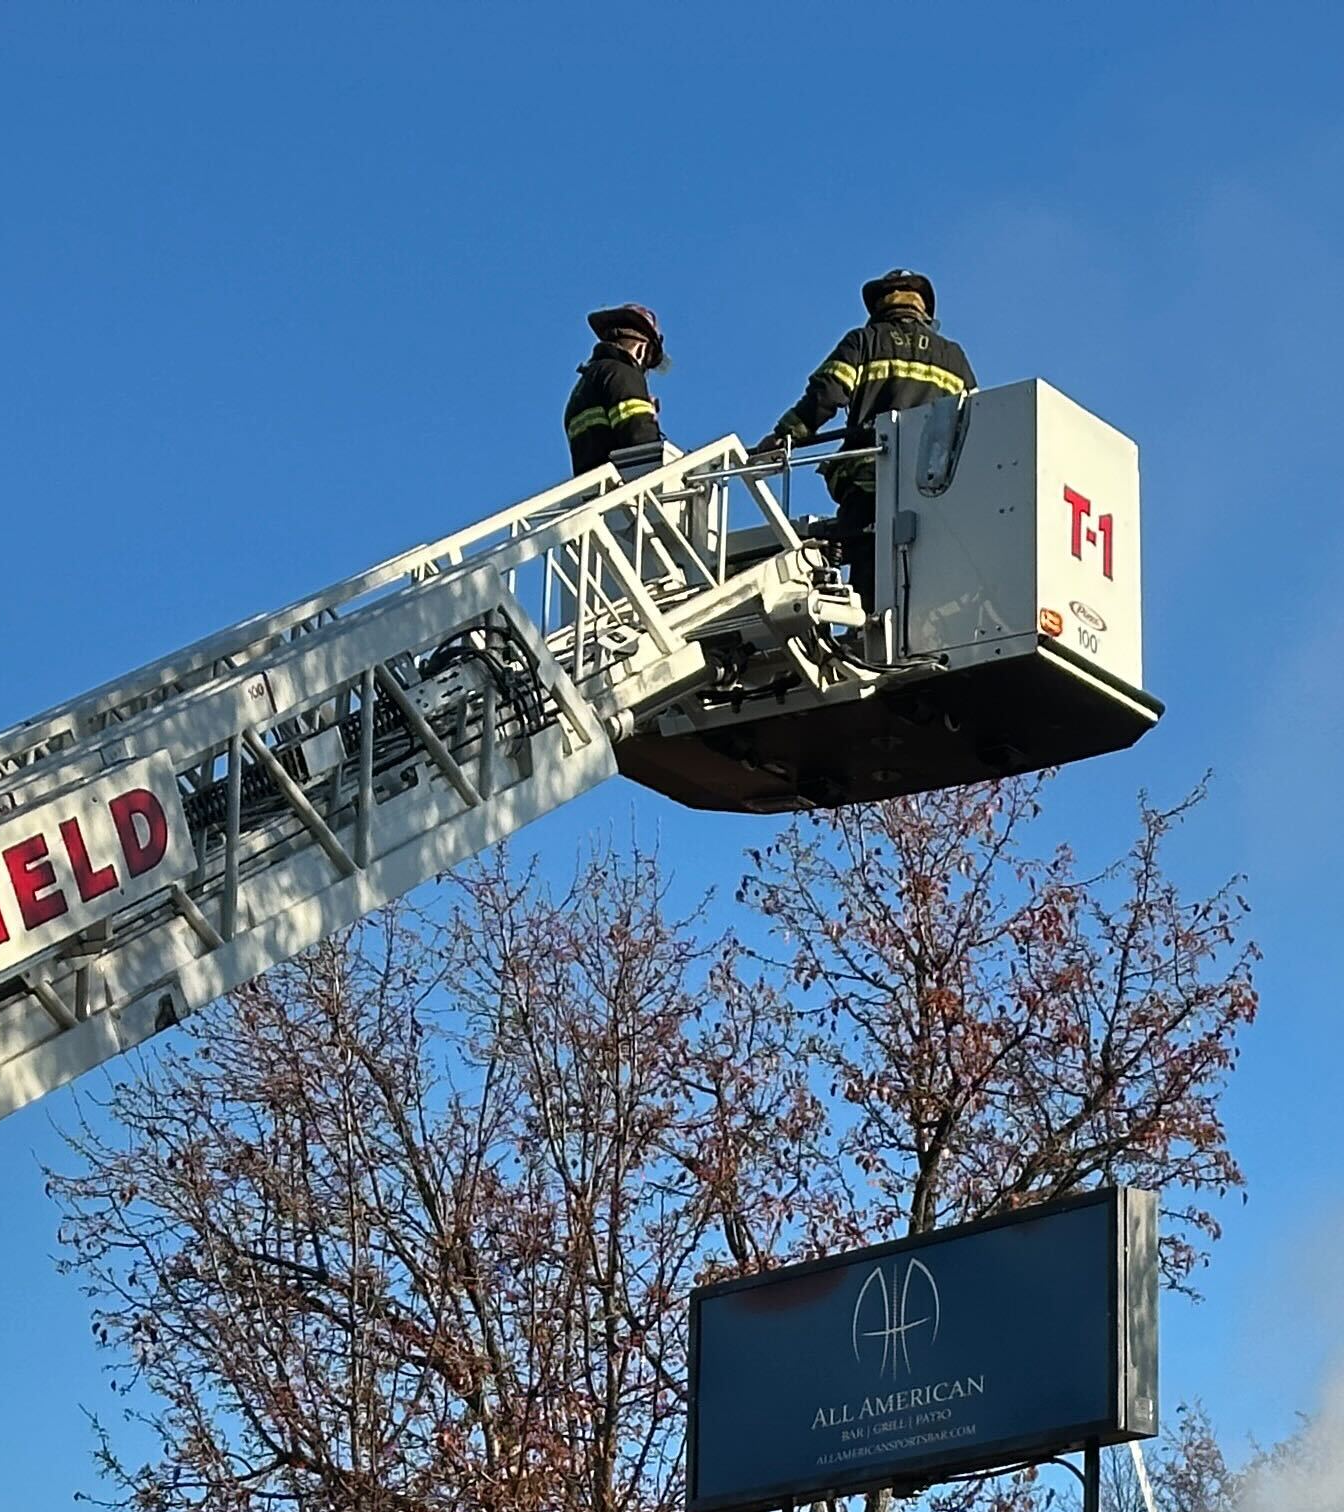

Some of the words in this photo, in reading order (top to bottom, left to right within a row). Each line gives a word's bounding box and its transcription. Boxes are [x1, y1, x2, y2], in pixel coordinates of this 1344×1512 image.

[1064, 483, 1113, 582] T-1
[810, 1404, 854, 1430] ALL
[858, 1375, 985, 1420] AMERICAN
[841, 1427, 864, 1442] BAR
[872, 1419, 905, 1435] GRILL
[915, 1408, 952, 1425] PATIO
